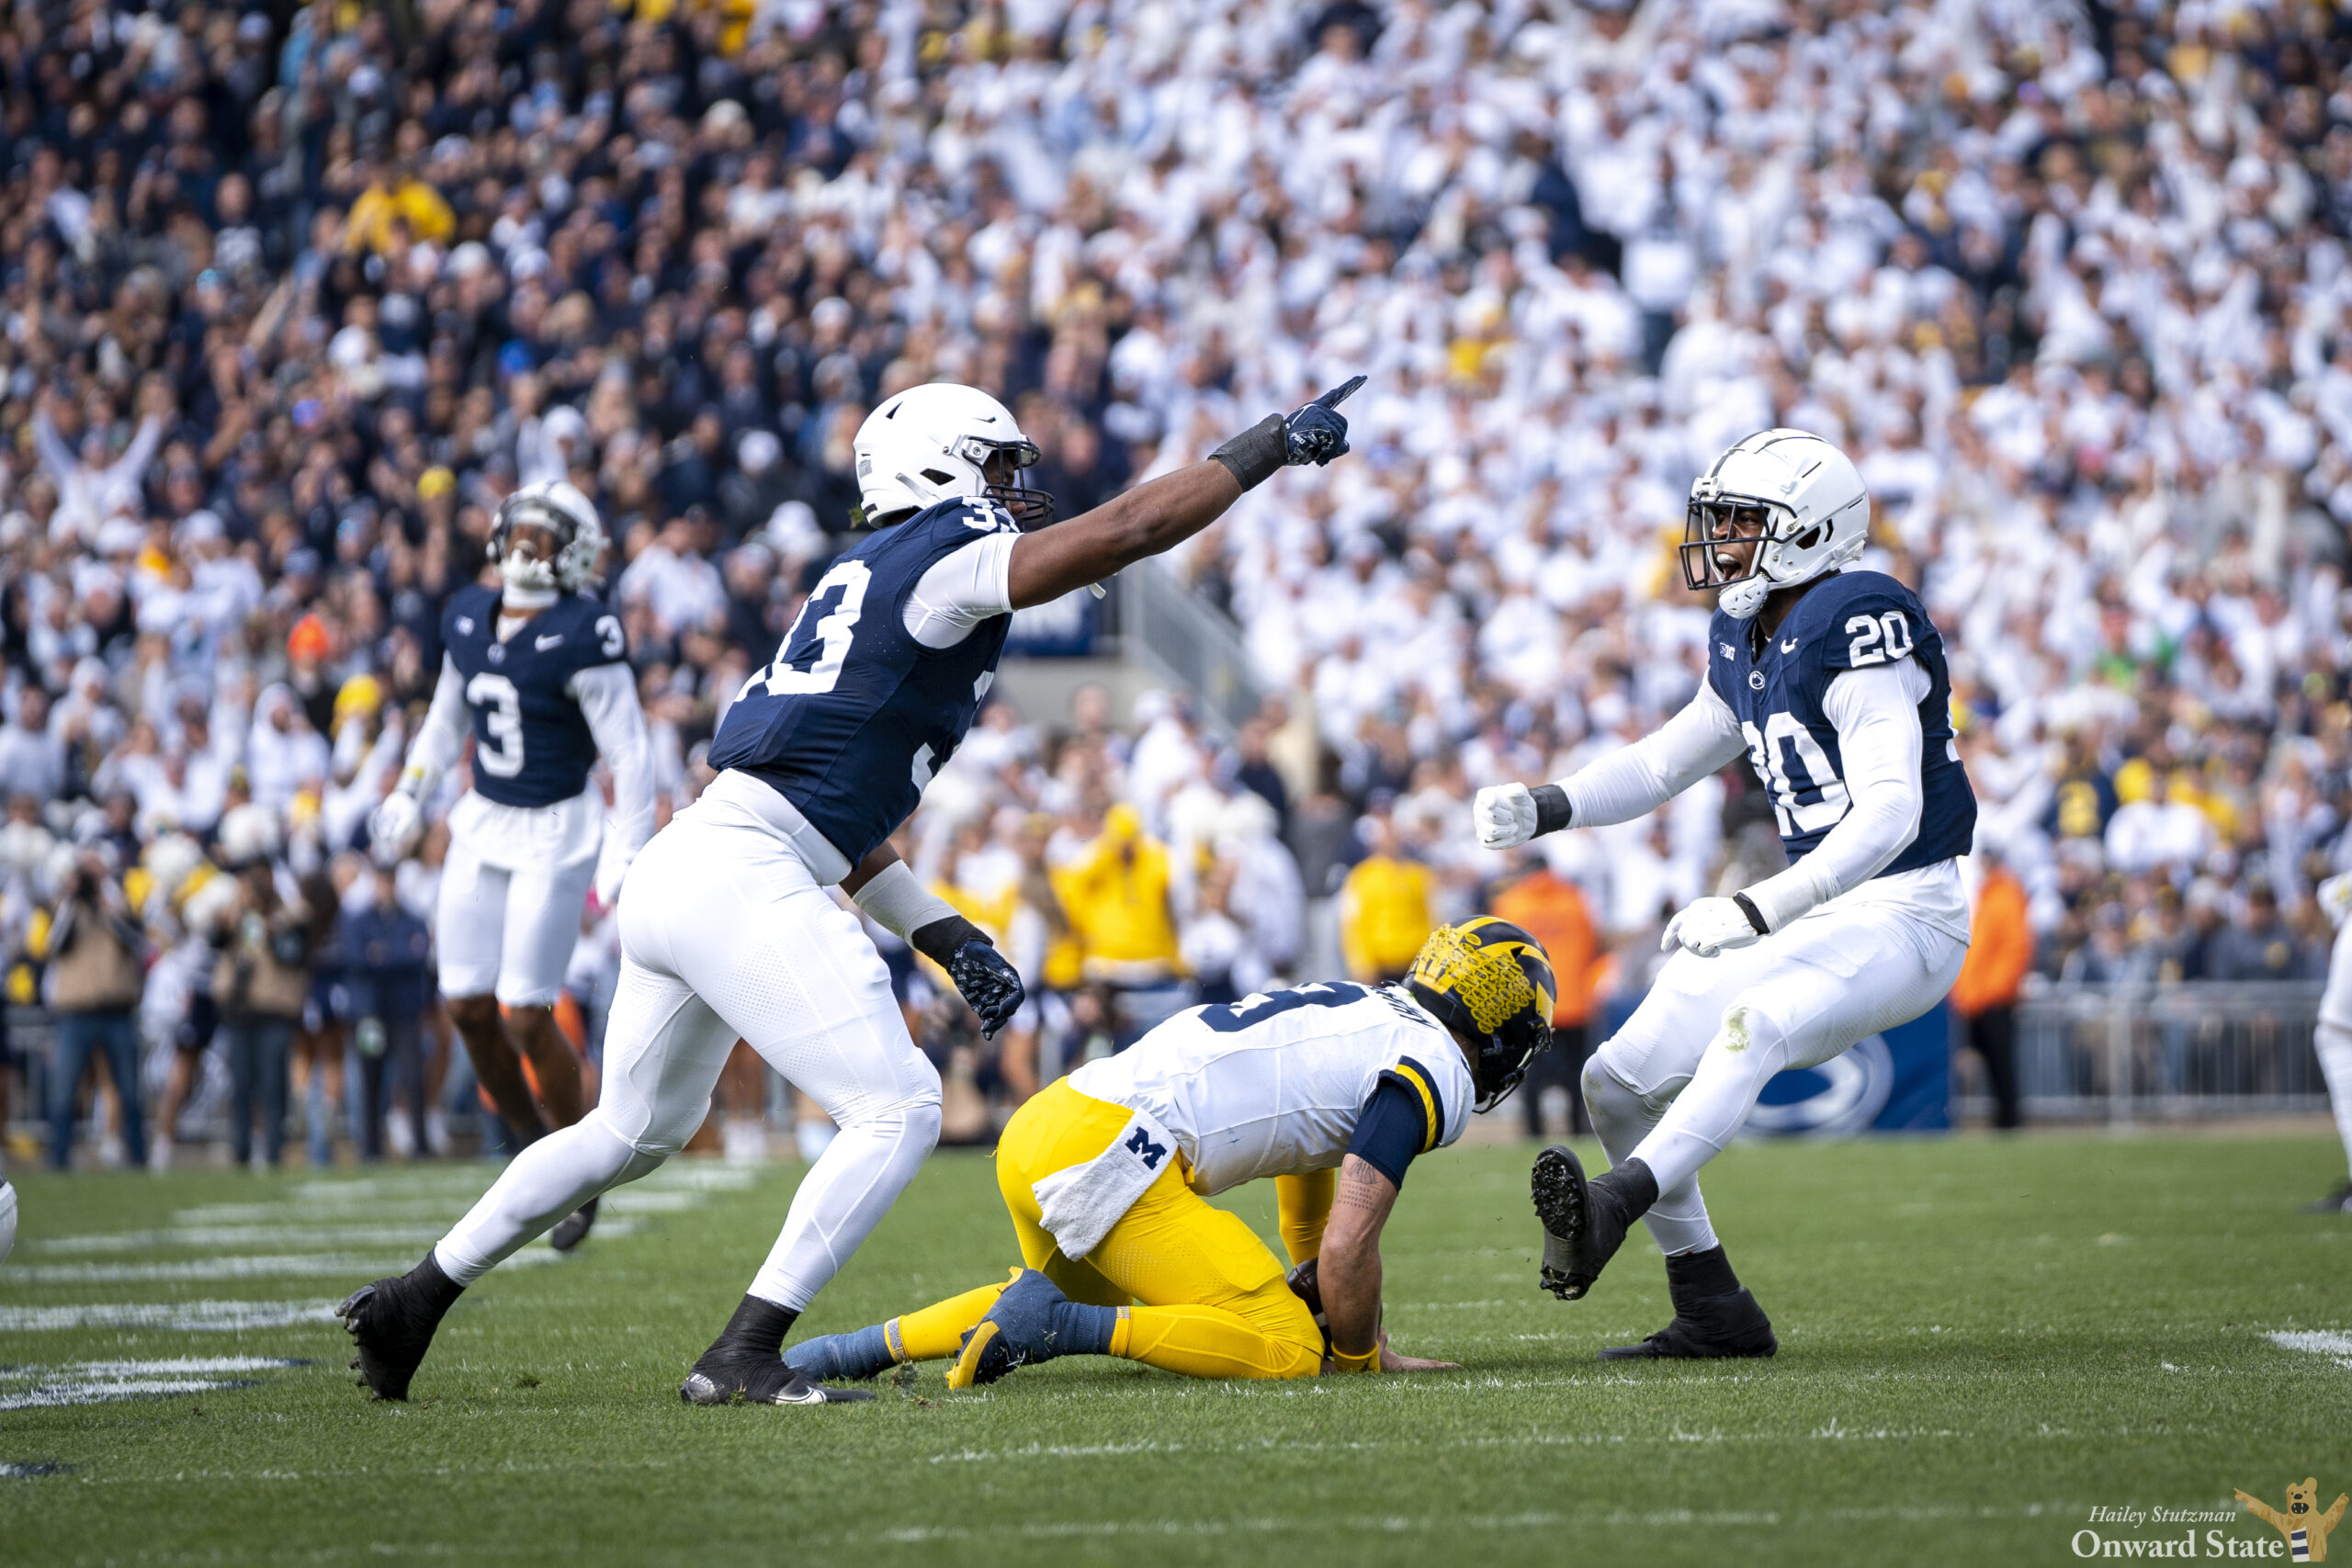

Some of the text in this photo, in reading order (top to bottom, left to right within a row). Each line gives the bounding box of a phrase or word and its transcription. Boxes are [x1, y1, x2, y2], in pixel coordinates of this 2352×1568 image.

[595, 615, 625, 657] 3
[1845, 610, 1914, 668] 20
[466, 671, 525, 778] 3
[1125, 1126, 1168, 1171] M
